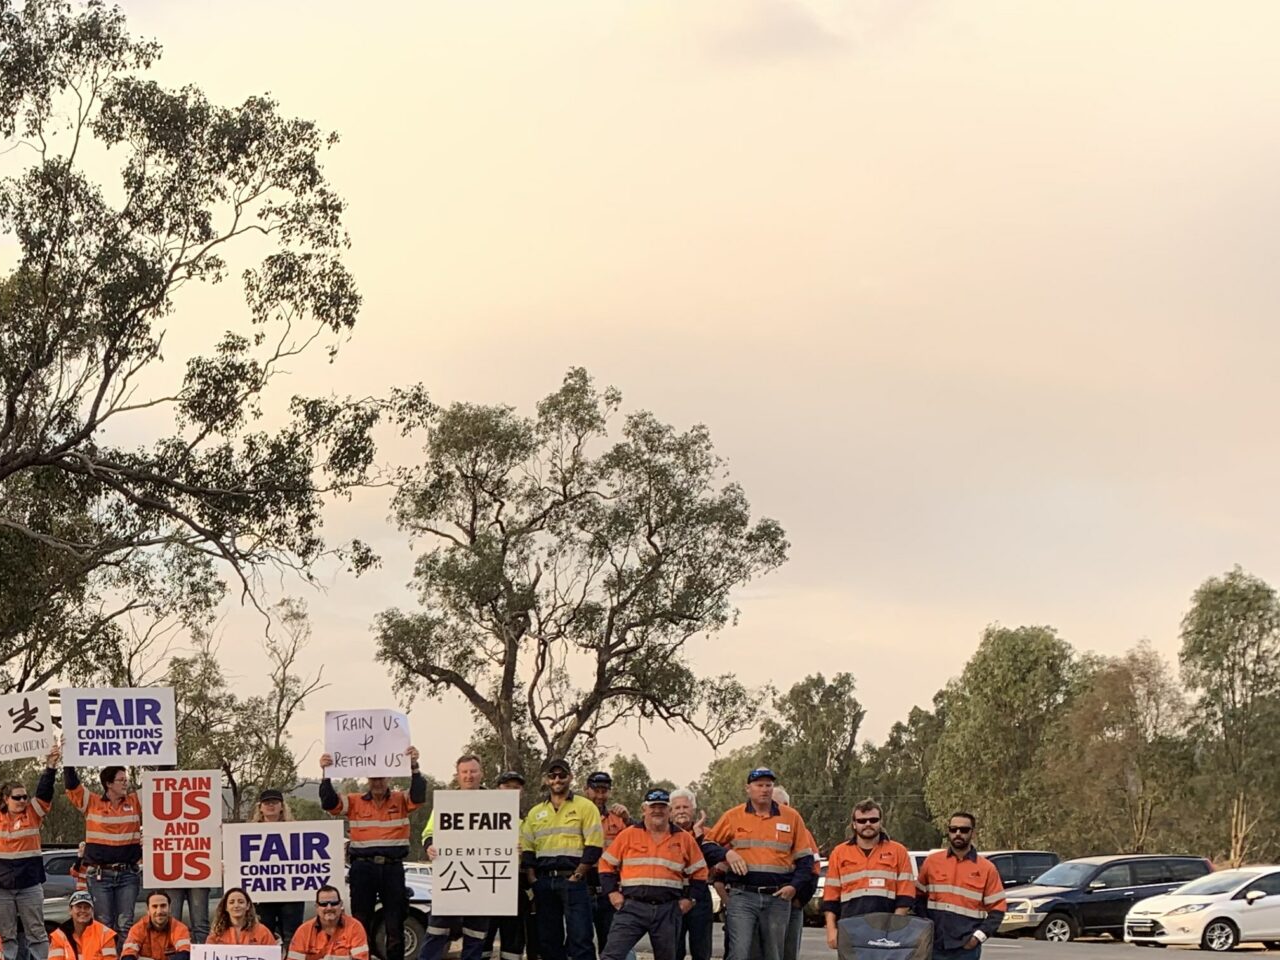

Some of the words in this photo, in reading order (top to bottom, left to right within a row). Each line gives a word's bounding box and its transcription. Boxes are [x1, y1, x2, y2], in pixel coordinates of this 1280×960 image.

[76, 698, 163, 726] FAIR
[333, 714, 373, 731] TRAIN
[383, 715, 400, 731] US
[77, 728, 163, 740] CONDITIONS
[0, 738, 49, 755] CONDITIONS
[78, 741, 122, 756] FAIR
[125, 740, 163, 755] PAY
[334, 751, 377, 768] RETAIN
[384, 752, 404, 768] US
[152, 777, 212, 791] TRAIN
[152, 791, 212, 821] US
[164, 822, 200, 836] AND
[440, 813, 465, 830] BE
[469, 812, 512, 830] FAIR
[152, 837, 212, 851] RETAIN
[240, 832, 331, 862] FAIR
[439, 847, 513, 856] IDEMITSU
[152, 851, 212, 881] US
[240, 862, 331, 876] CONDITIONS
[241, 877, 287, 892] FAIR
[291, 875, 331, 891] PAY
[439, 860, 512, 894] 公平
